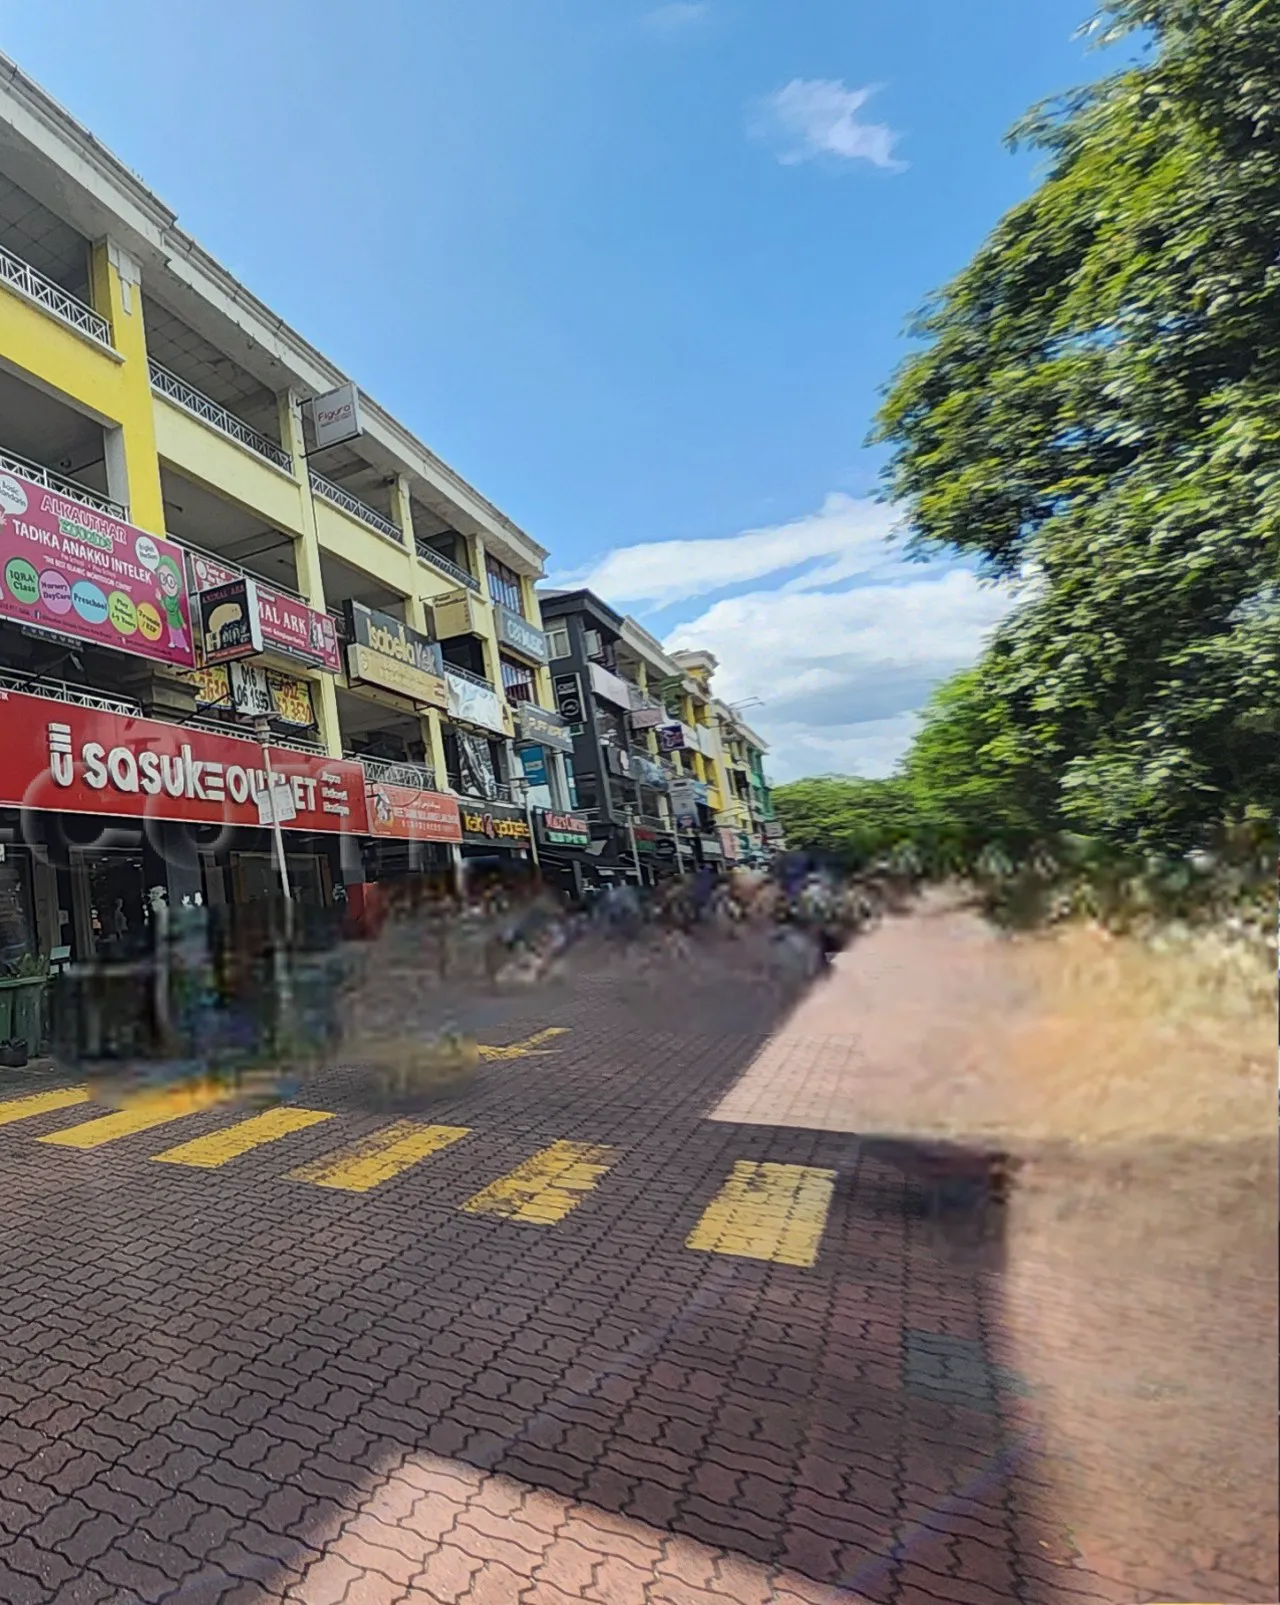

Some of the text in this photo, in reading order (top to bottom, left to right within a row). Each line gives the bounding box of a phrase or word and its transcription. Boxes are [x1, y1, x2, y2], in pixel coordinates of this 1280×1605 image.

[40, 494, 127, 545] ALKAUTHAR
[12, 519, 152, 585] TADIKA ANAKKU INTELEK
[13, 581, 36, 593] Class
[73, 592, 108, 611] Preschool
[283, 612, 308, 636] ARK
